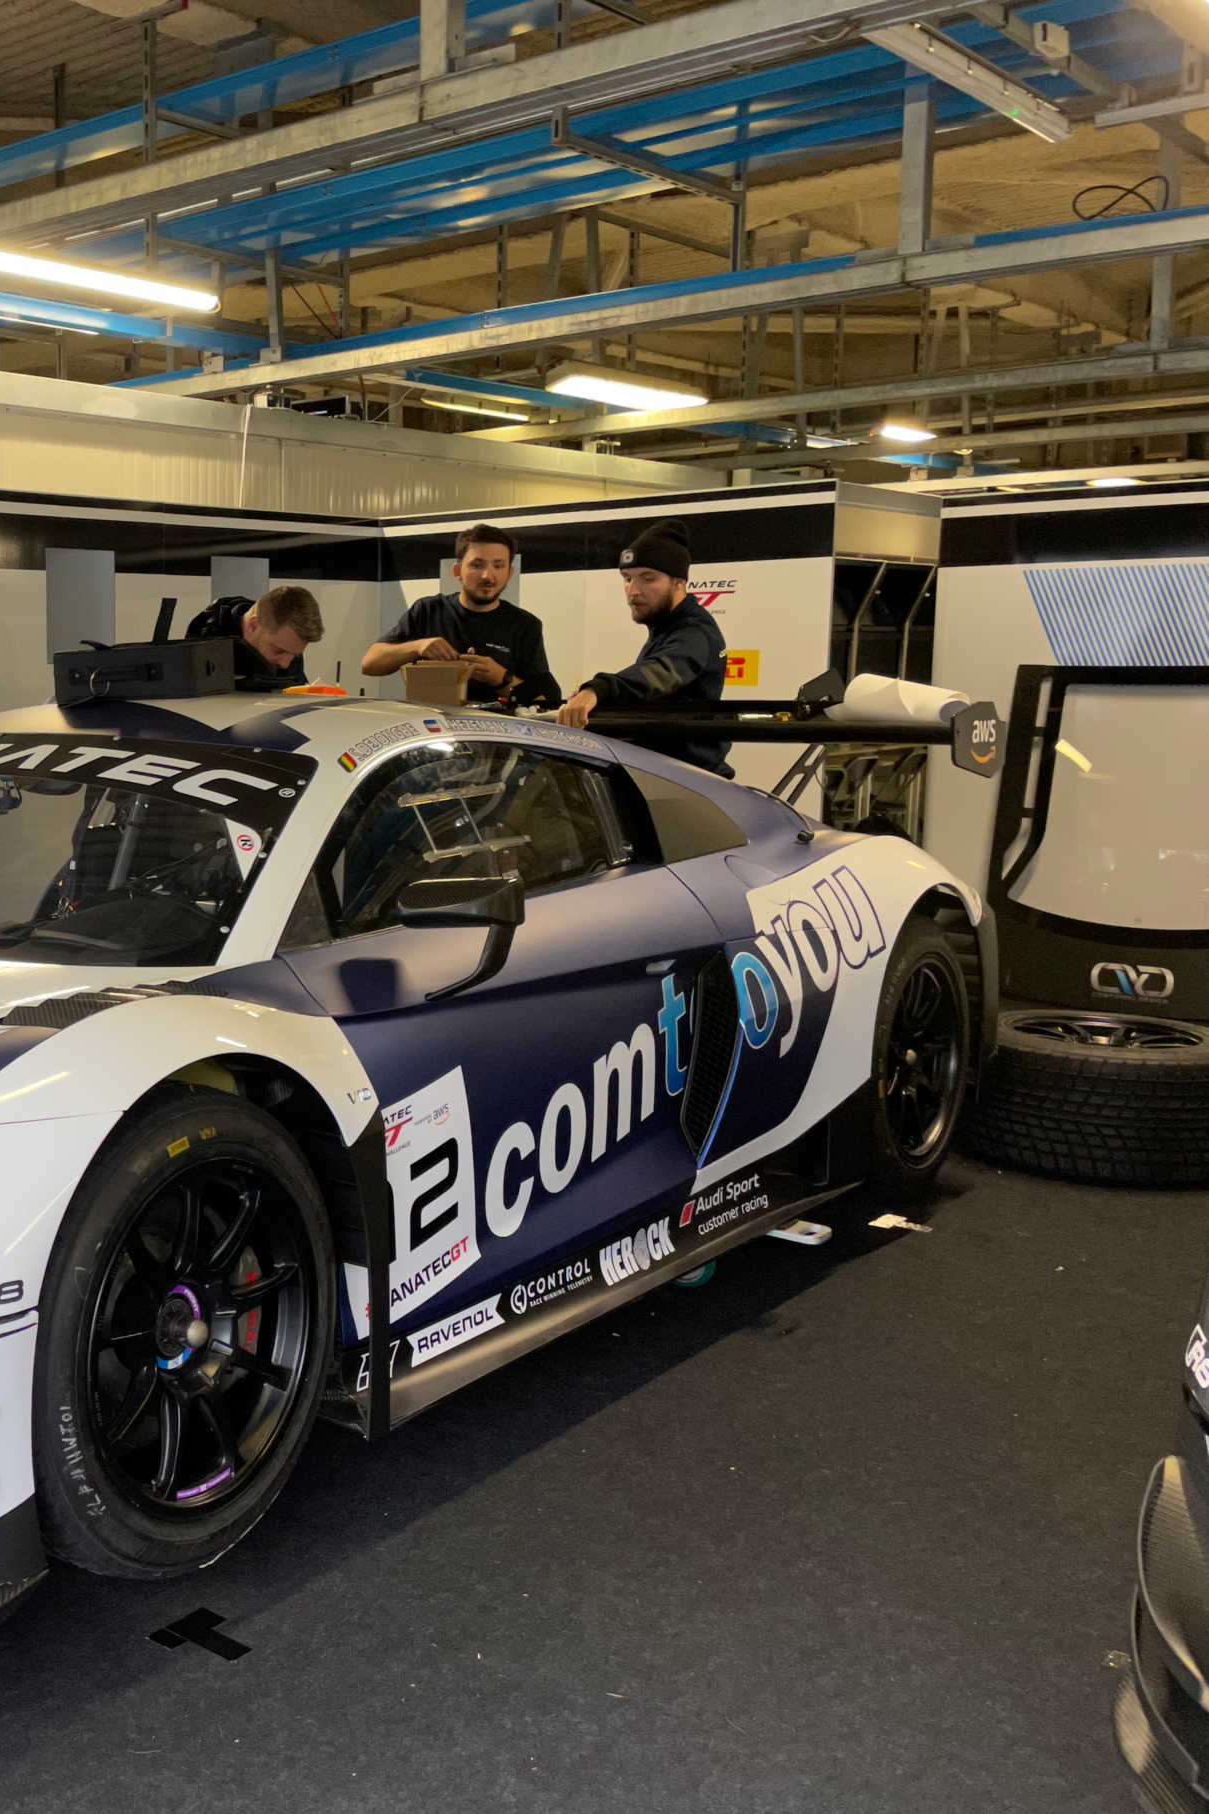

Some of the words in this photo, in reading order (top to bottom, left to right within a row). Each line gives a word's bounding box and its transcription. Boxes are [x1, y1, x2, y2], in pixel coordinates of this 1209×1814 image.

[688, 580, 737, 589] NATEC
[972, 719, 996, 744] aws
[433, 1104, 450, 1120] aws
[695, 1187, 724, 1215] Audi
[725, 1173, 761, 1201] Sport
[698, 1205, 740, 1236] customer
[740, 1194, 769, 1215] racing
[599, 1216, 676, 1287] HEROCK
[527, 1257, 591, 1298] CONTROL
[417, 1308, 494, 1353] RAVENOL
